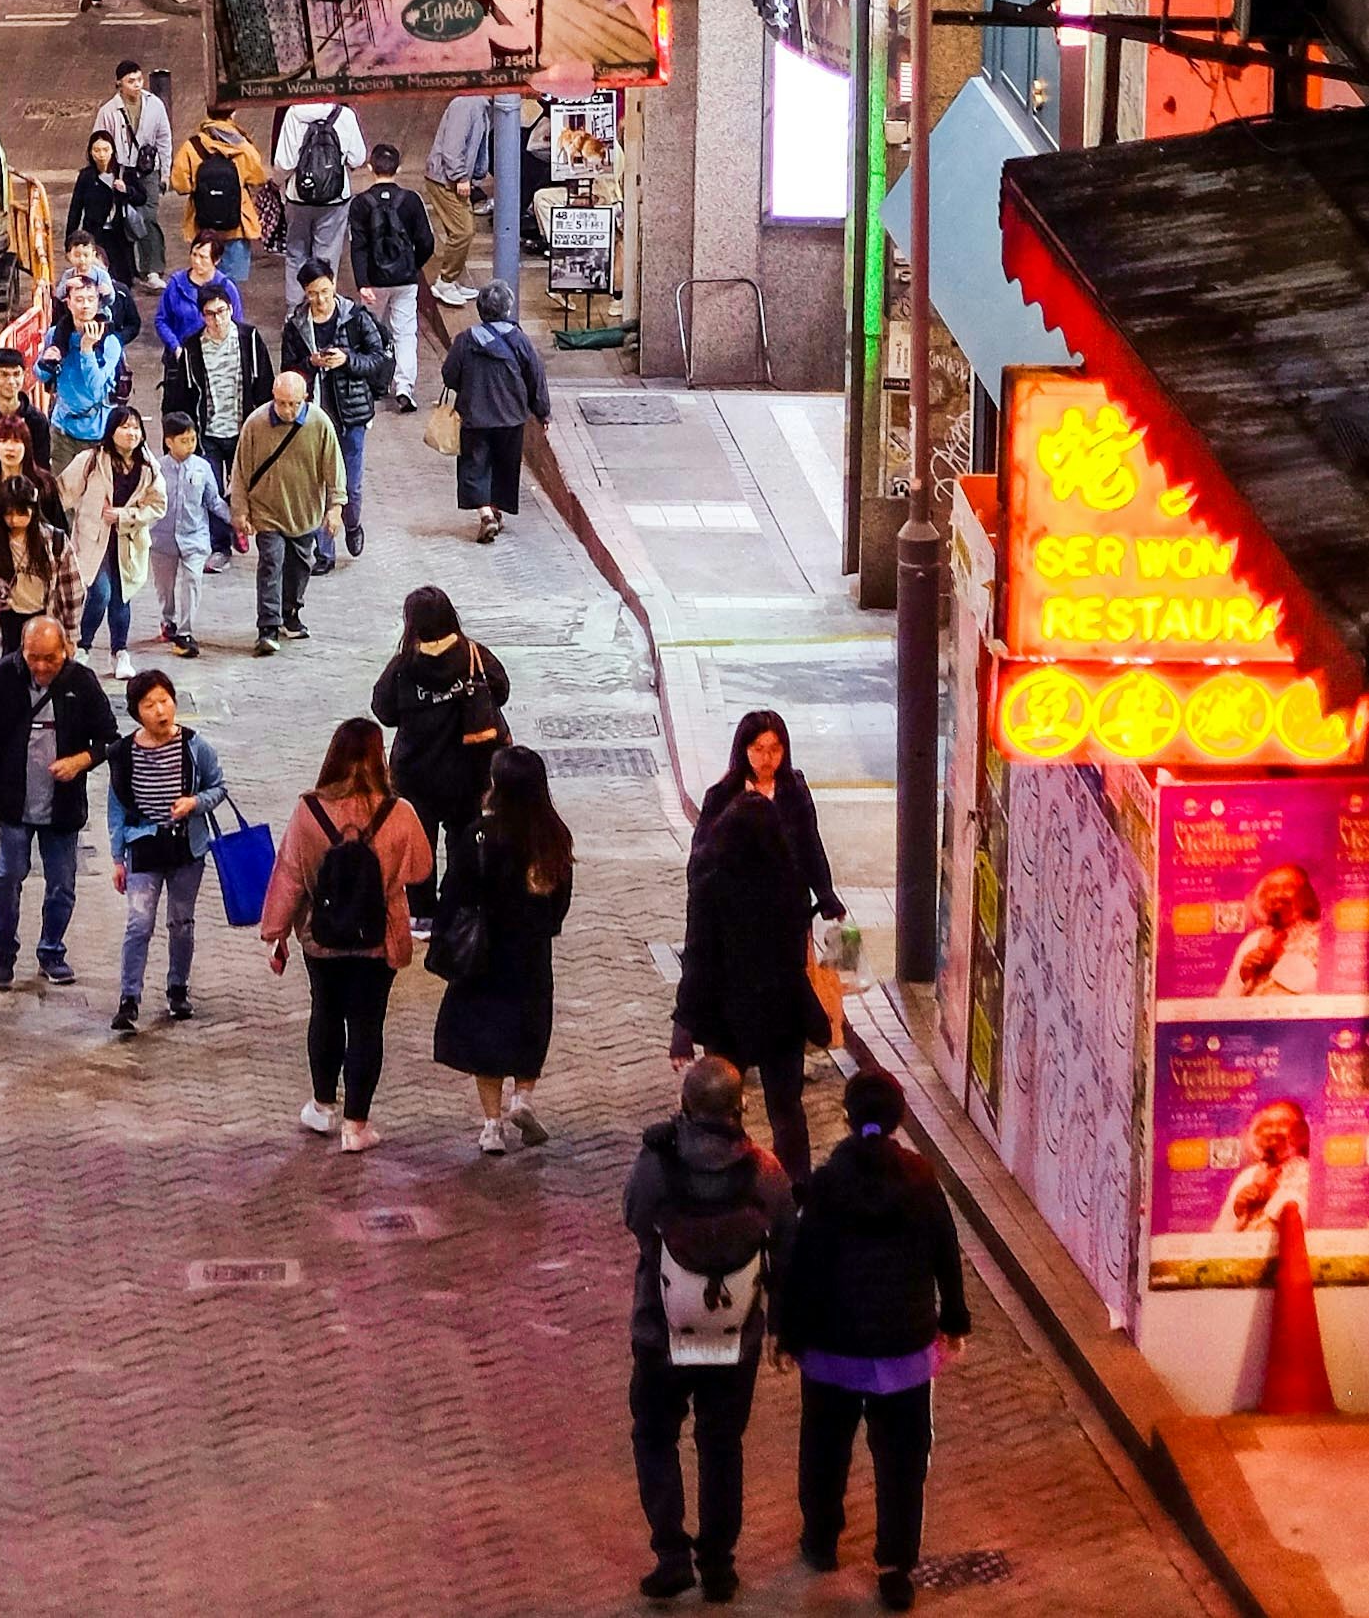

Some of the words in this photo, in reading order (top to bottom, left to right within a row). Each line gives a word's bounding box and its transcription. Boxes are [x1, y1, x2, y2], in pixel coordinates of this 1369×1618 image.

[240, 83, 273, 97] Nails
[287, 80, 335, 95] Waxing
[348, 78, 394, 91] Facials
[407, 72, 467, 88] Massage
[482, 71, 508, 85] Spa
[555, 211, 568, 220] 48
[1034, 536, 1123, 578] SER
